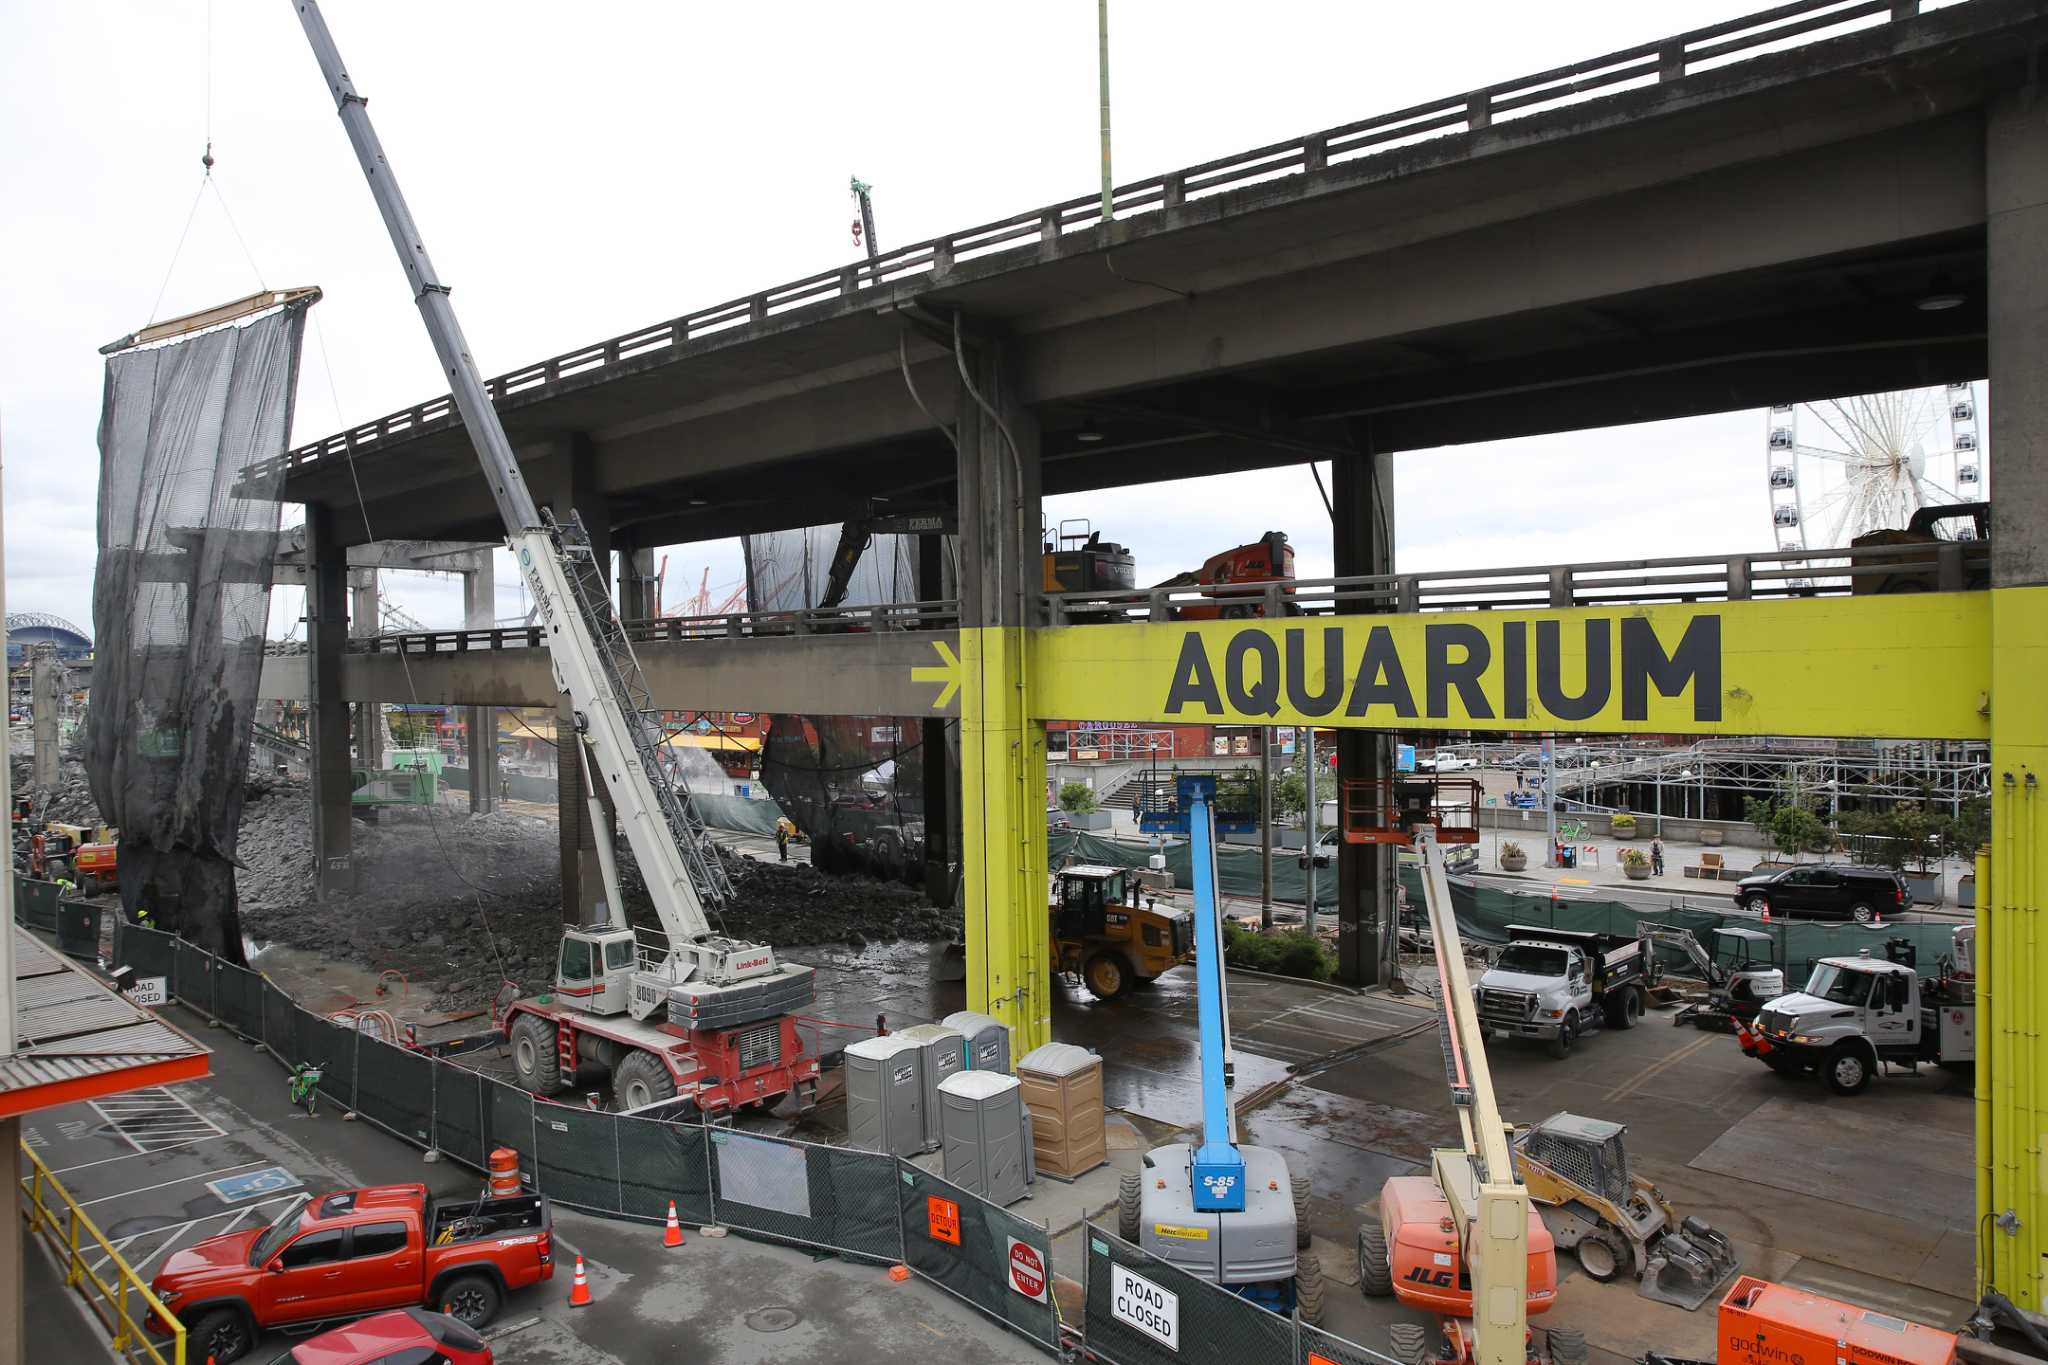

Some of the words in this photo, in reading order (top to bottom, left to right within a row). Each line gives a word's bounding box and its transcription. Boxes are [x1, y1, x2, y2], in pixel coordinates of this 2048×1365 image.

[1164, 614, 1722, 721] AQUARIUM
[736, 956, 769, 970] Link-Belt
[134, 992, 161, 1003] OSED
[636, 985, 657, 1005] 8090
[1203, 1175, 1236, 1187] S-85
[931, 1213, 957, 1230] DETOUR
[1014, 1249, 1024, 1261] DO
[1025, 1256, 1038, 1268] NOT
[1016, 1272, 1039, 1290] ENTER
[1403, 1266, 1454, 1289] JLG
[1125, 1276, 1163, 1310] ROAD
[1117, 1295, 1171, 1338] CLOSED
[1729, 1335, 1788, 1361] godwin
